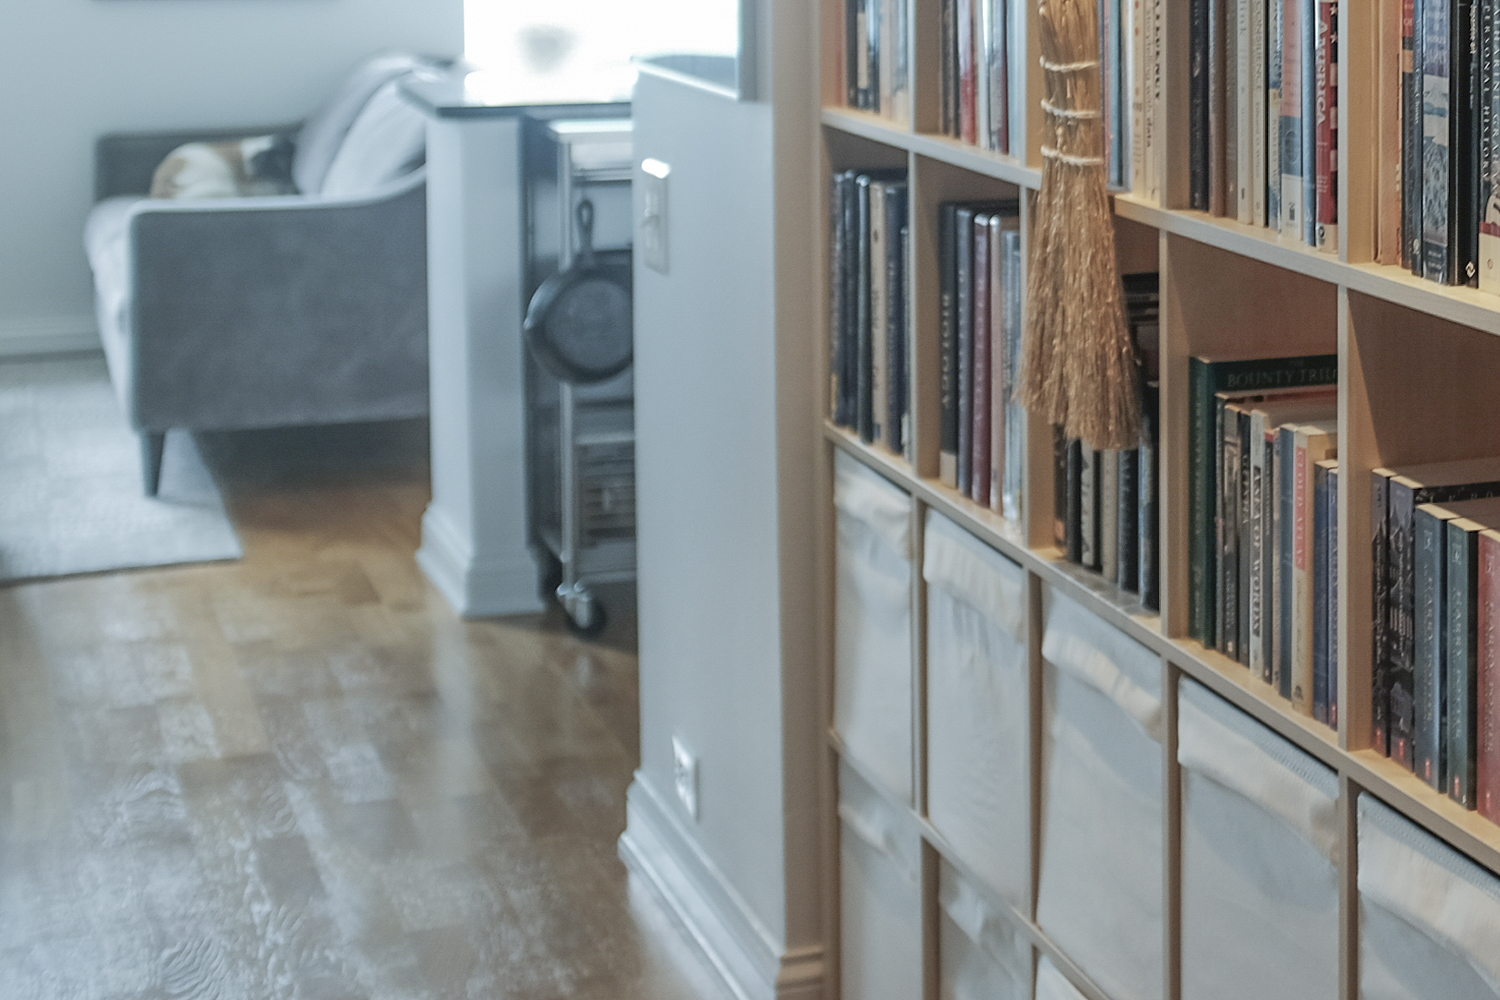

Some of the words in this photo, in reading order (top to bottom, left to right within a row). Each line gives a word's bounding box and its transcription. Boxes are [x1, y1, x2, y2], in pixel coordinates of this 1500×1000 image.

[1145, 10, 1153, 81] storytelling
[1255, 0, 1264, 92] CONSILIENCE
[1469, 4, 1477, 41] Japanese
[1469, 42, 1477, 54] art
[1483, 4, 1491, 92] PERSONAL
[1145, 85, 1153, 111] with
[1316, 20, 1328, 126] AMERICA
[1145, 117, 1153, 148] data
[1482, 105, 1490, 179] HISTORY
[941, 293, 950, 409] BIOLOGY
[1253, 487, 1261, 520] SEA
[1296, 448, 1304, 508] CLOUD
[1253, 525, 1261, 549] OF
[1296, 516, 1304, 567] ATLAS
[1252, 559, 1261, 633] WORDS
